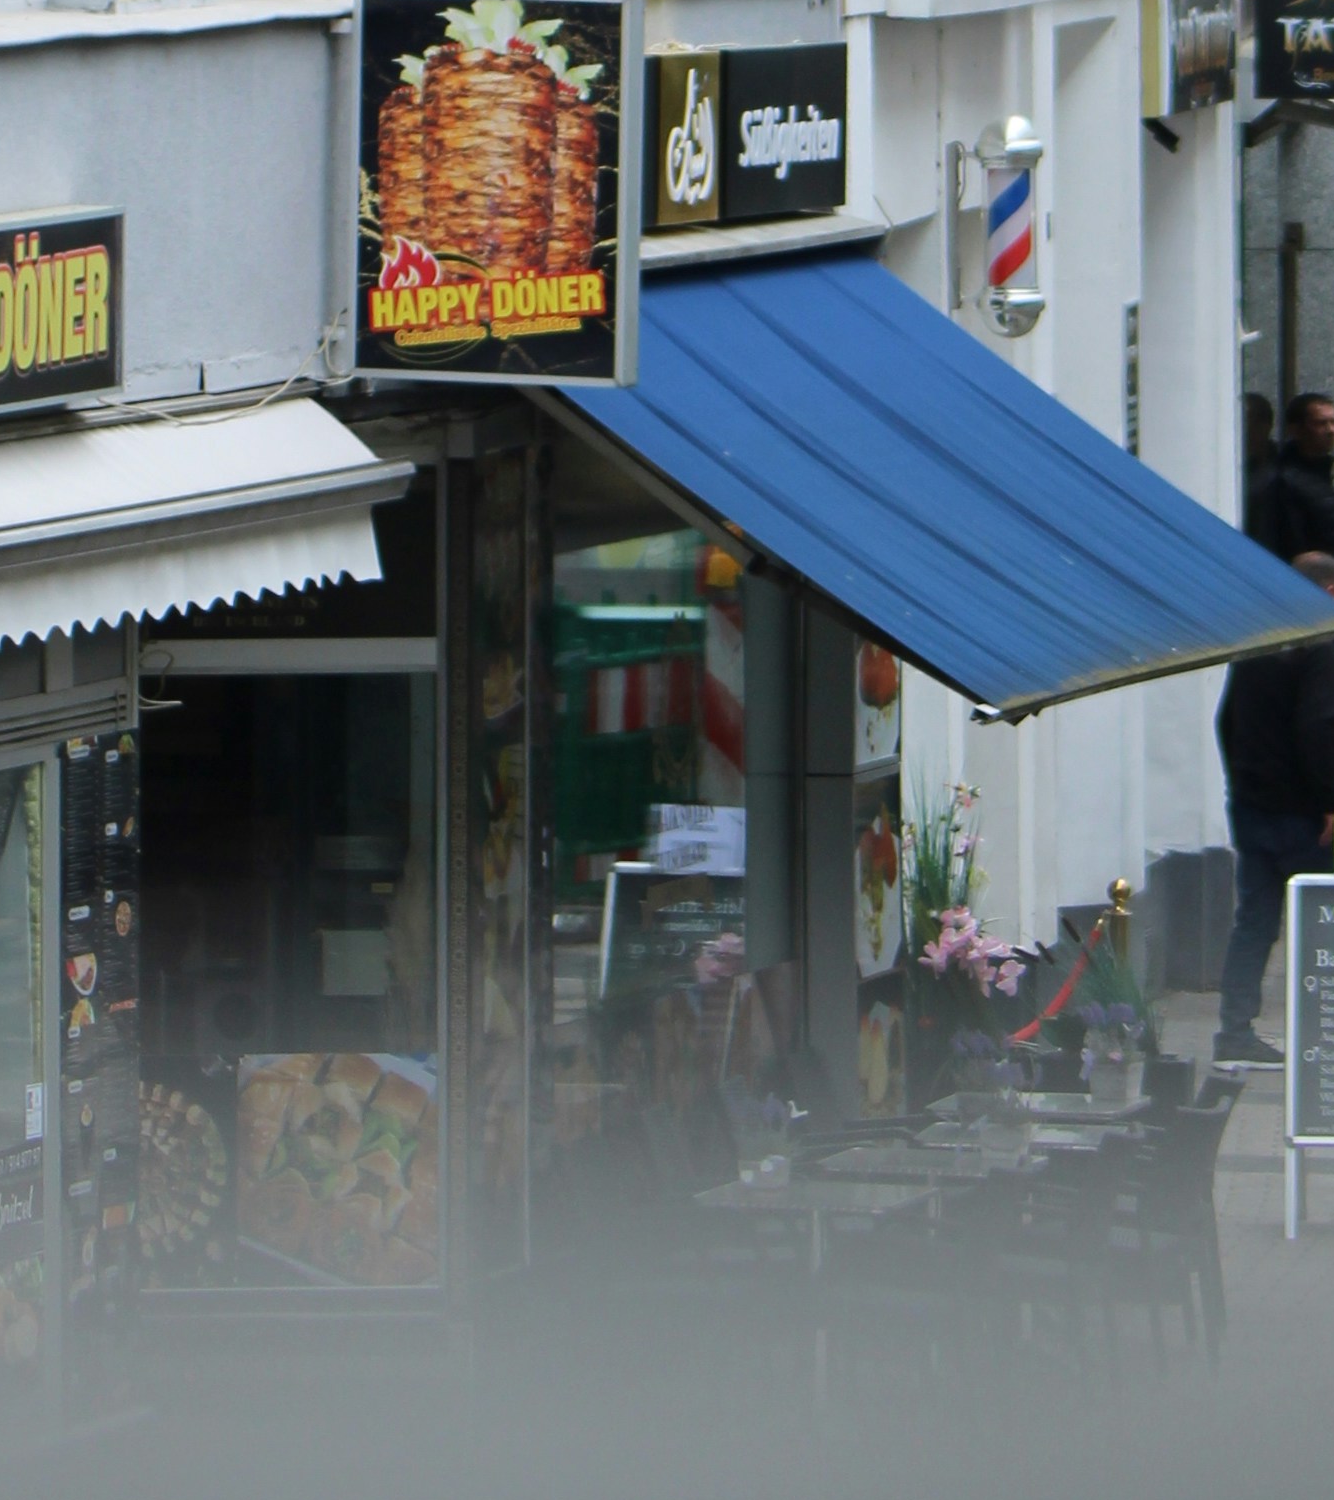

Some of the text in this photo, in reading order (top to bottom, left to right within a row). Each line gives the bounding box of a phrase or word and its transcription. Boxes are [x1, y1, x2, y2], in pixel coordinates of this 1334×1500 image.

[738, 103, 841, 180] Süßigkeiten
[369, 268, 605, 330] HAPPY DÖNER
[491, 314, 582, 339] Spezialitäten
